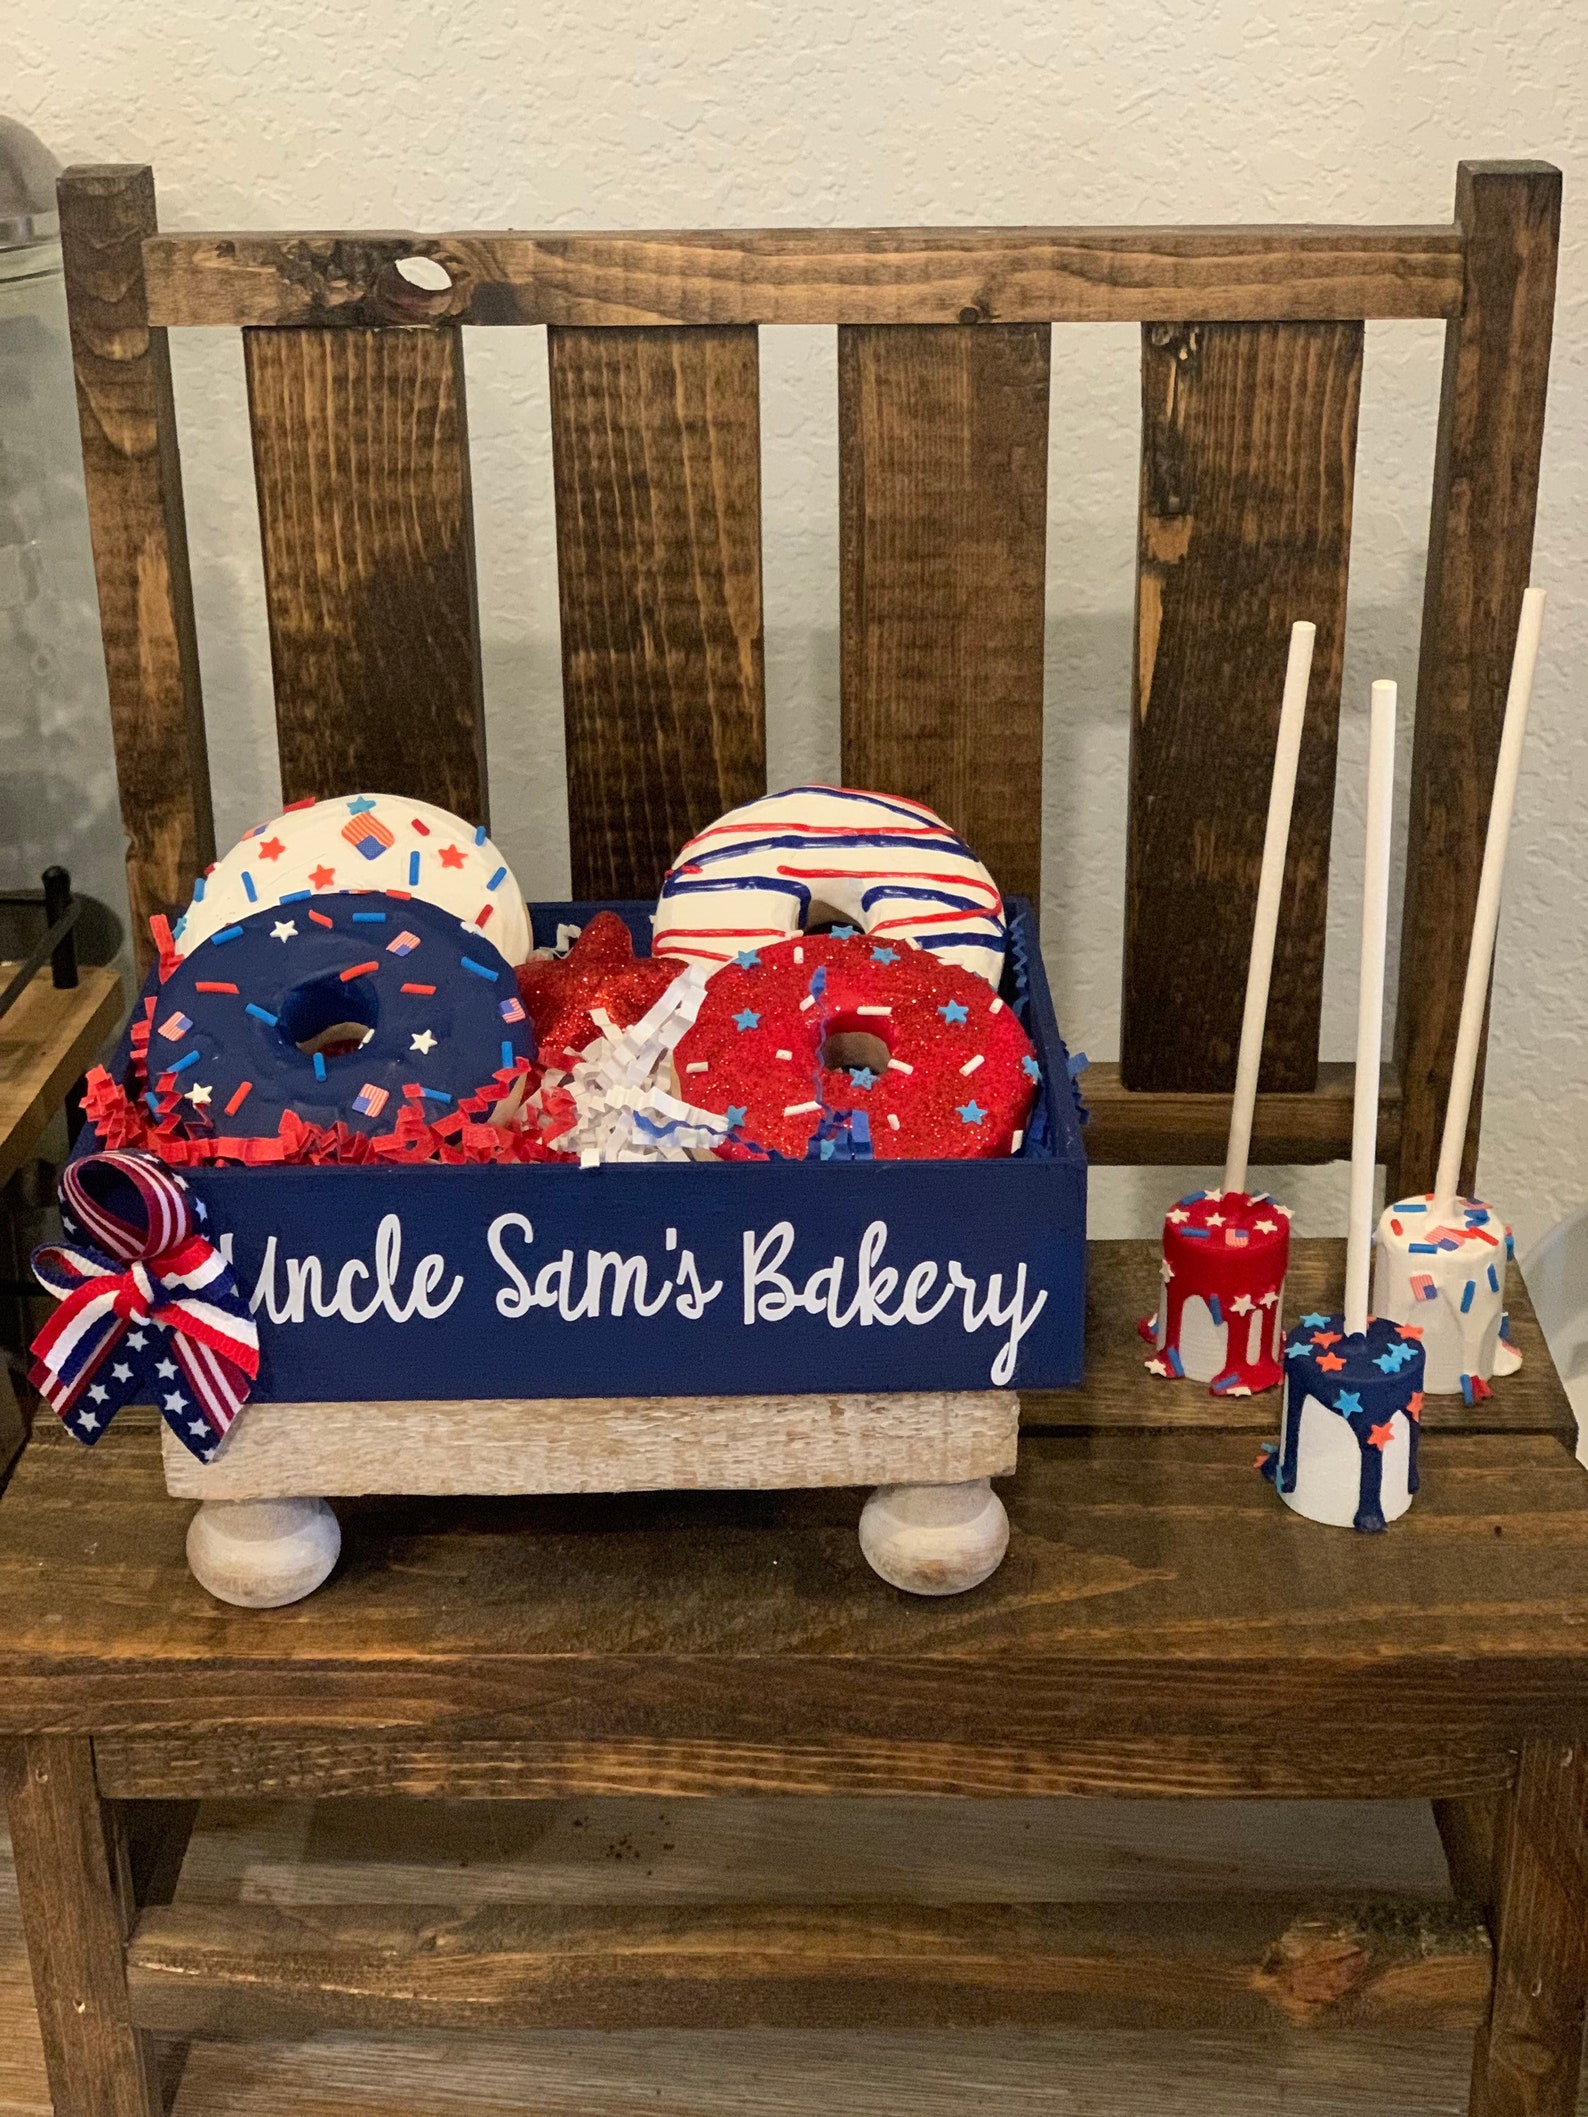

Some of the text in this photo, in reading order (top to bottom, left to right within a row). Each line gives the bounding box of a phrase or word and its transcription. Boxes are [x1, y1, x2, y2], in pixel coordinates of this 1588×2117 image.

[220, 1212, 1049, 1386] Uncle Sam's Bakery
